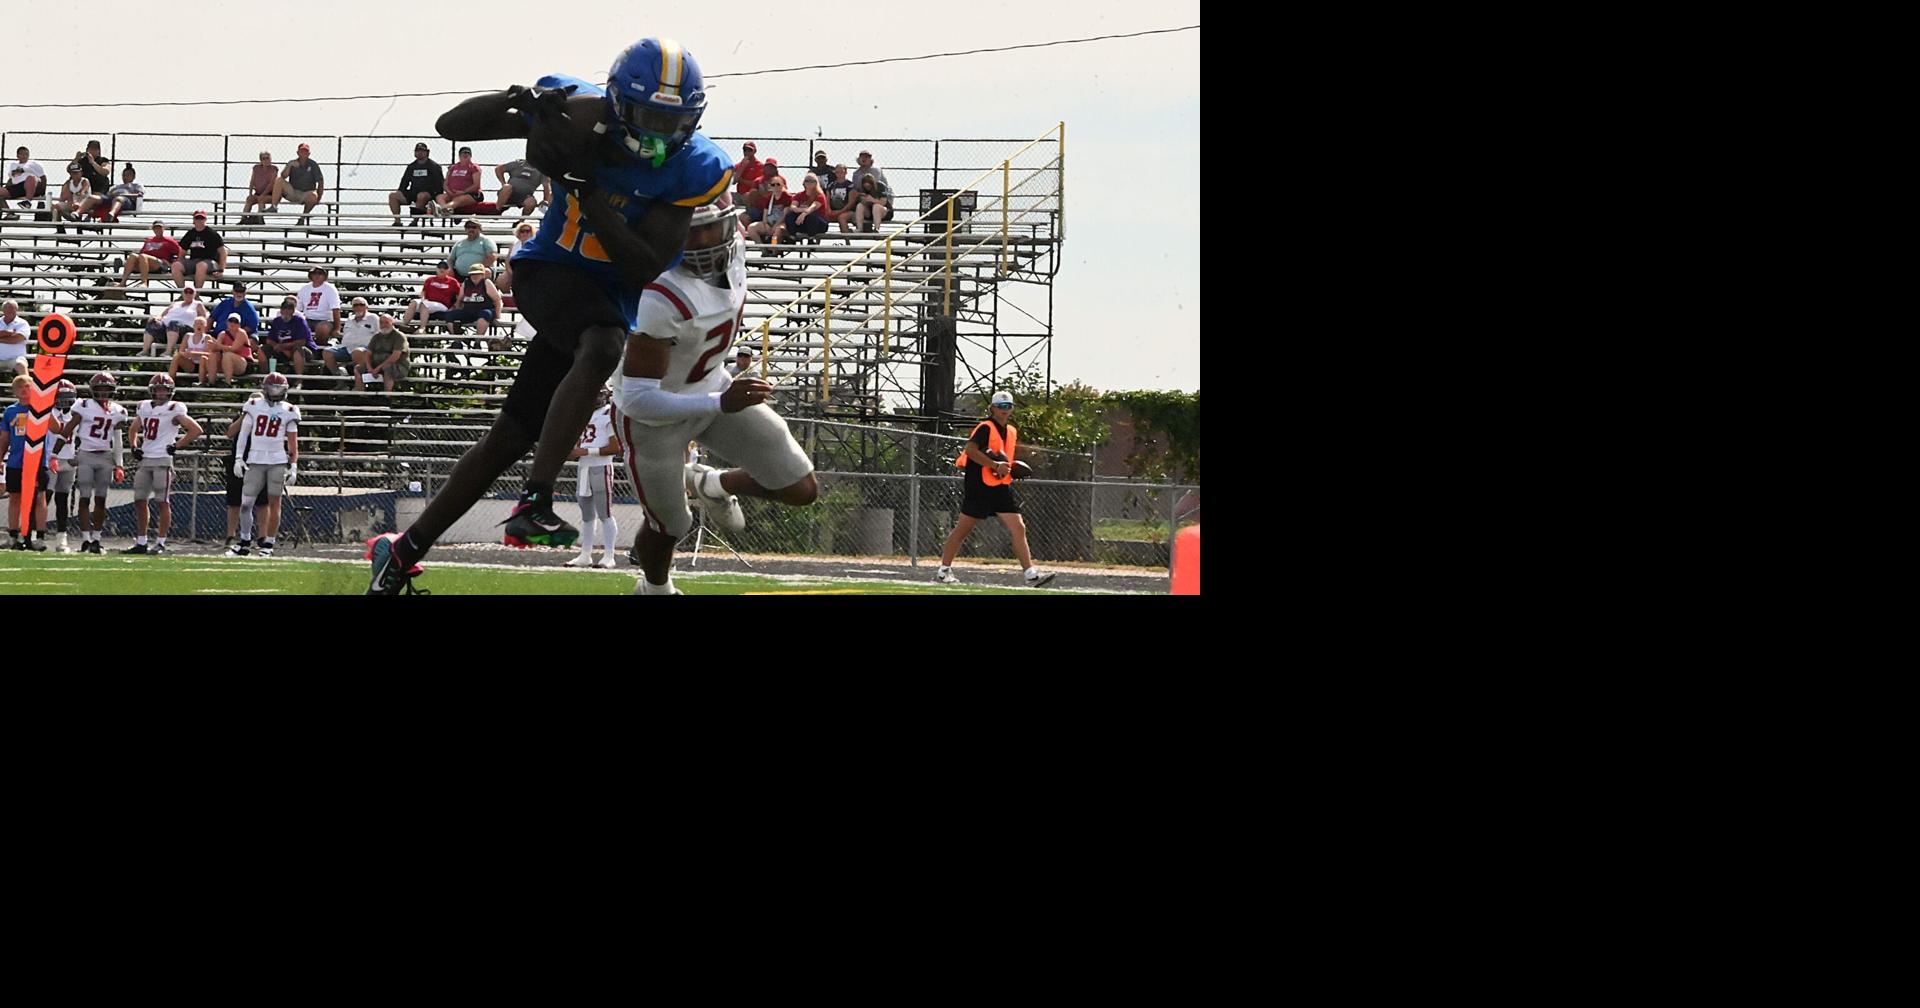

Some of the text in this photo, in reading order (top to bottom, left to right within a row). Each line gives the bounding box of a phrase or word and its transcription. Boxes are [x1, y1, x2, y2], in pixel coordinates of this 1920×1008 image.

[89, 416, 113, 440] 21
[143, 417, 160, 440] 18
[254, 414, 282, 437] 88
